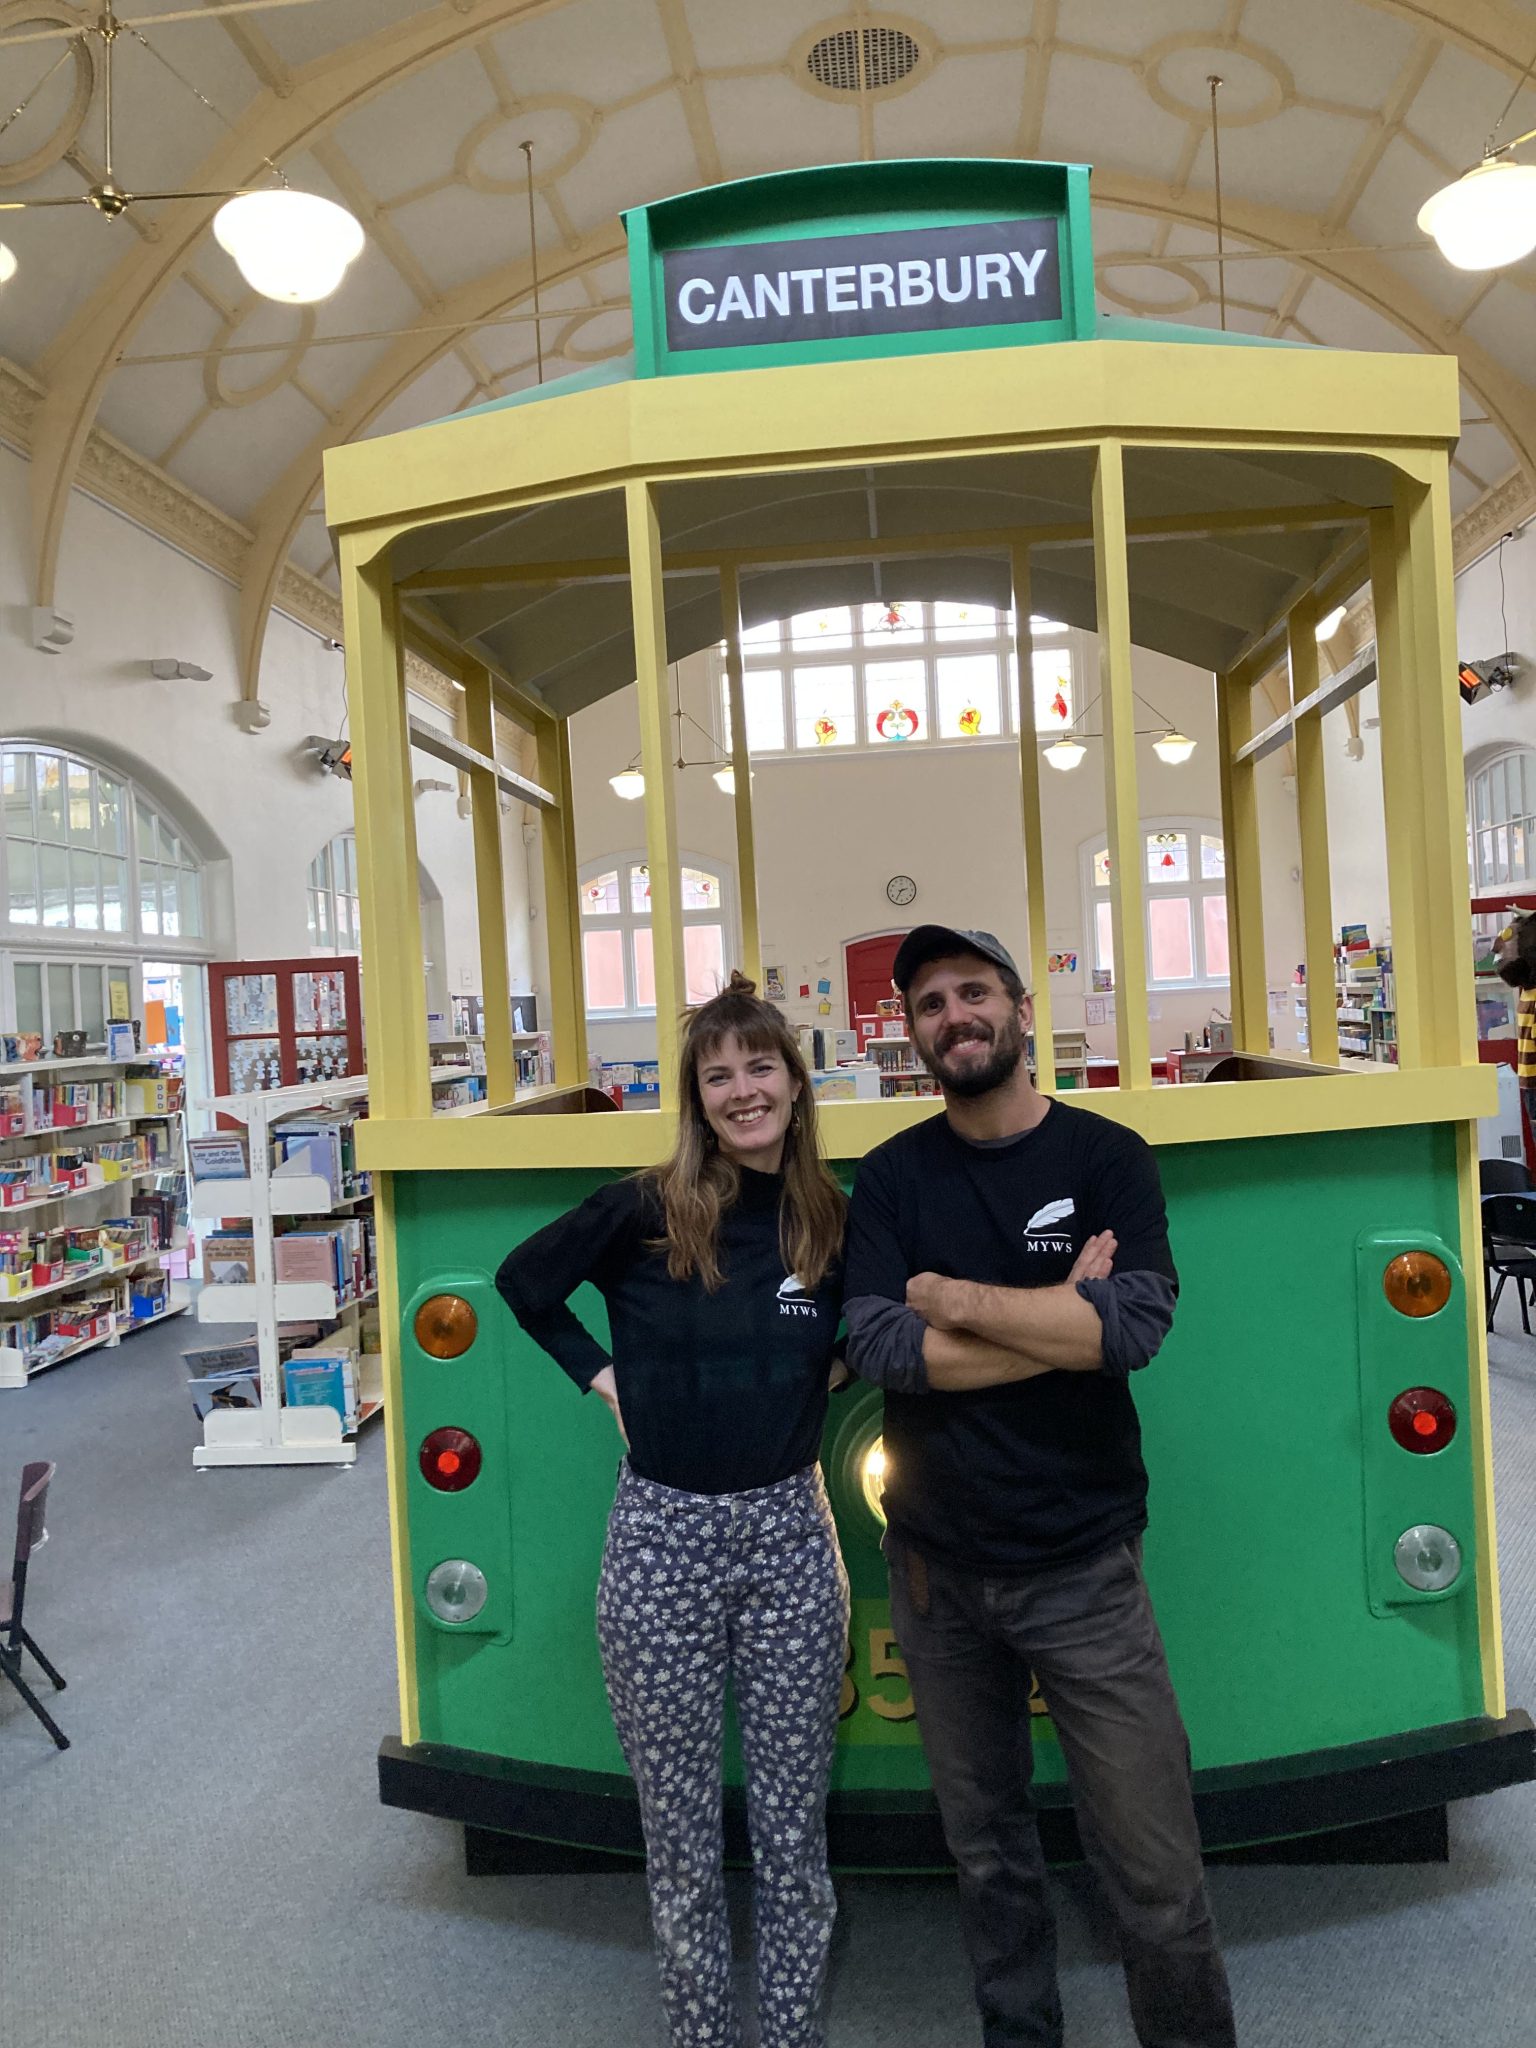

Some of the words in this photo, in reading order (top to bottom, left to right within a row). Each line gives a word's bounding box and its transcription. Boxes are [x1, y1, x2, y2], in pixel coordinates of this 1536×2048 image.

[678, 248, 1047, 325] CANTERBURY
[1026, 1240, 1072, 1253] MYWS
[779, 1303, 818, 1318] MYWS
